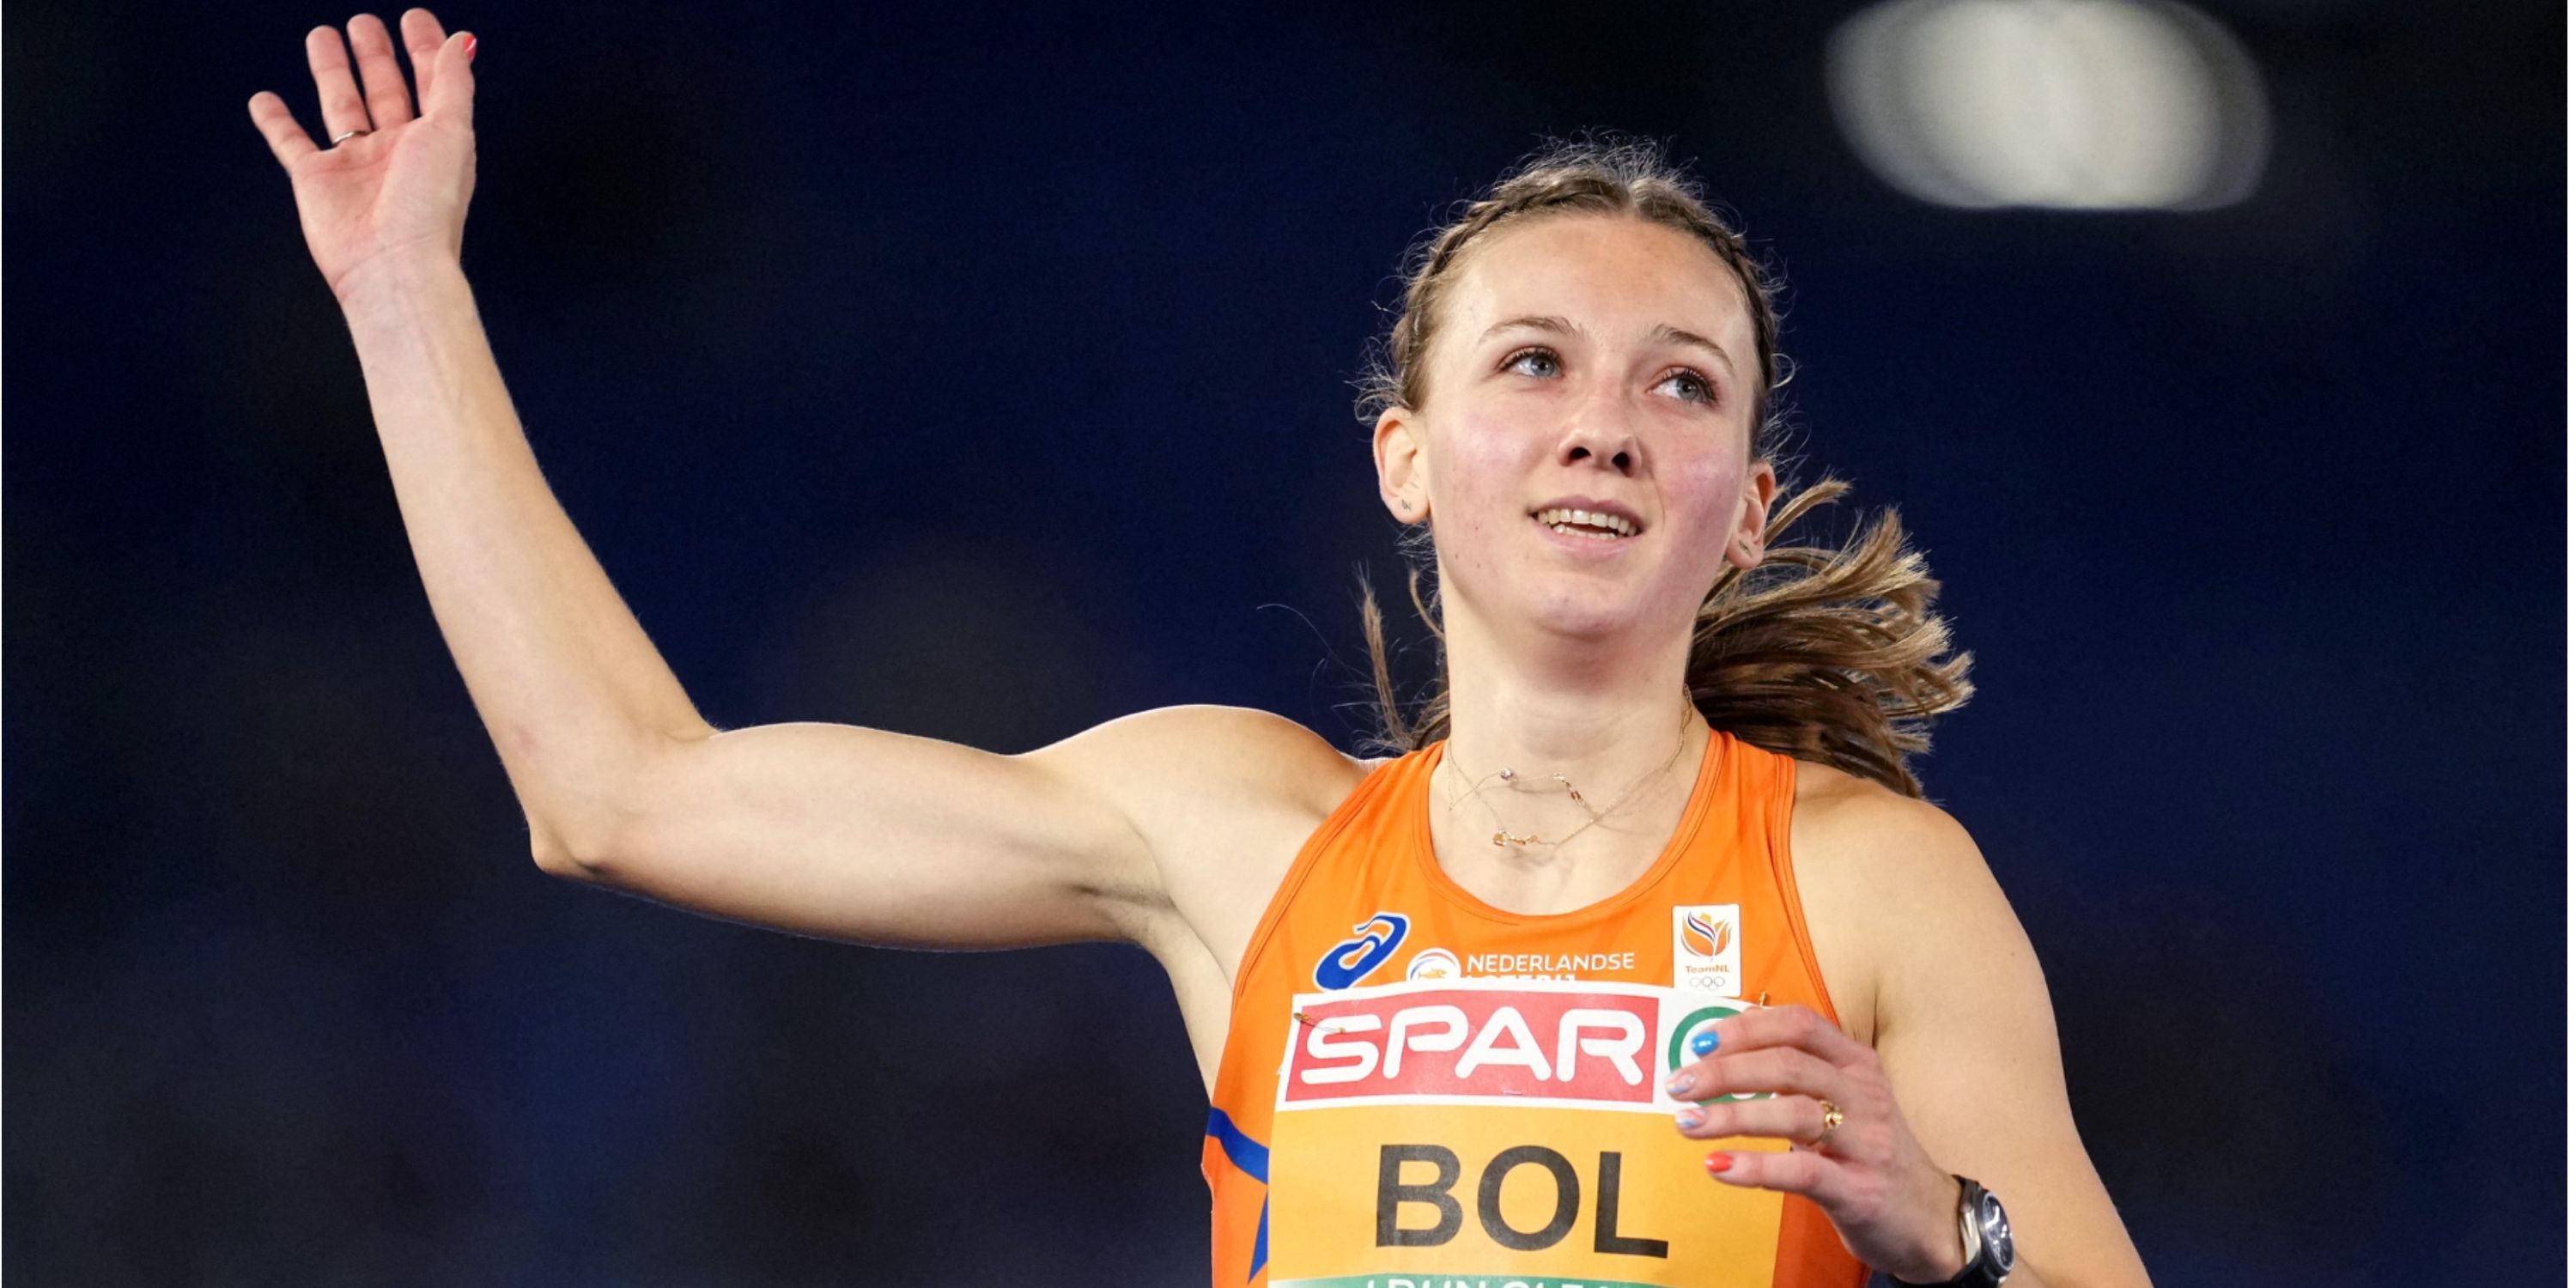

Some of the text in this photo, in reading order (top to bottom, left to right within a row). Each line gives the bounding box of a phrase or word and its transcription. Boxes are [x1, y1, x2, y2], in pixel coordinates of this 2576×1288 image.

[1467, 952, 1635, 973] NEDERLANDSE
[1685, 964, 1731, 974] TeamNL
[1300, 1004, 1646, 1085] SPAR
[1376, 1144, 1669, 1260] BOL
